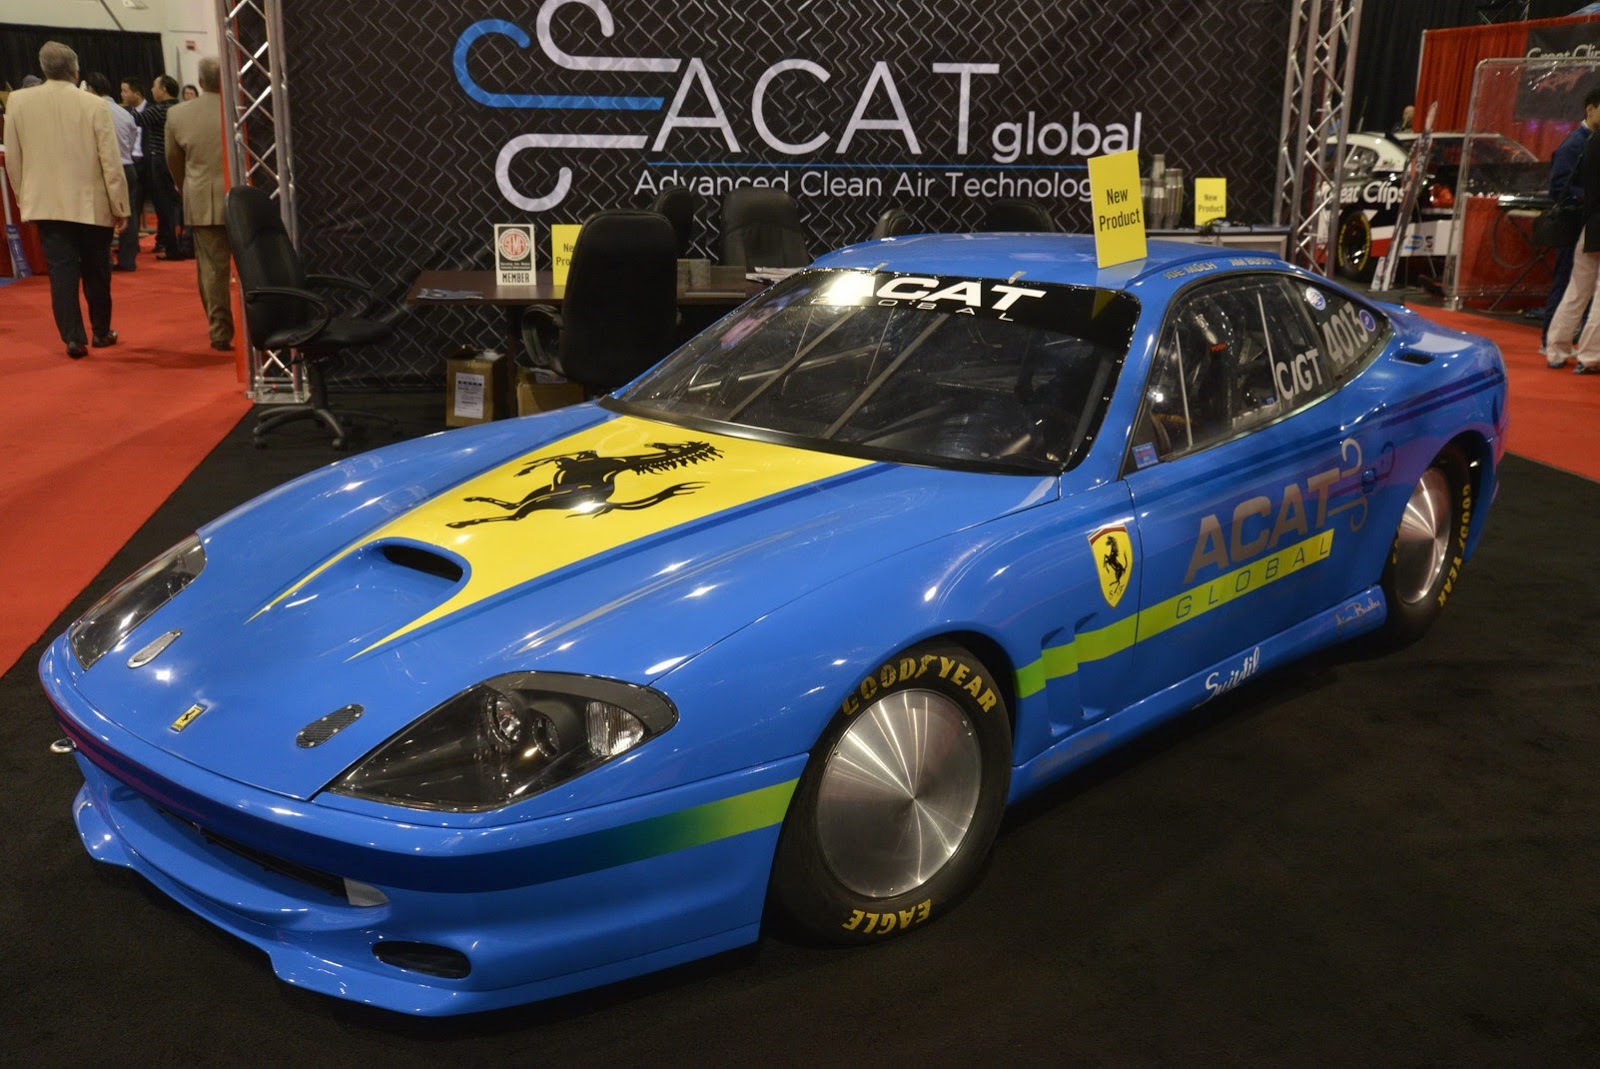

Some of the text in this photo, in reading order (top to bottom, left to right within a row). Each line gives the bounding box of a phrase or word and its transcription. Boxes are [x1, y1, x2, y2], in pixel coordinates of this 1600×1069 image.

[651, 56, 1142, 164] ACAT global
[800, 170, 882, 198] Clean
[892, 172, 936, 198] Air
[945, 172, 1094, 202] Technolog
[1105, 187, 1129, 206] New
[1203, 194, 1218, 202] New
[1099, 208, 1141, 232] Product
[1197, 203, 1225, 215] Product
[563, 243, 576, 253] Ne
[501, 272, 530, 284] MEMBER
[1322, 301, 1369, 365] 4013
[1183, 467, 1340, 585] ACAT
[1175, 537, 1329, 620] GLOBAL
[841, 654, 997, 715] GOODYEAR
[841, 898, 932, 935] EAGLE
